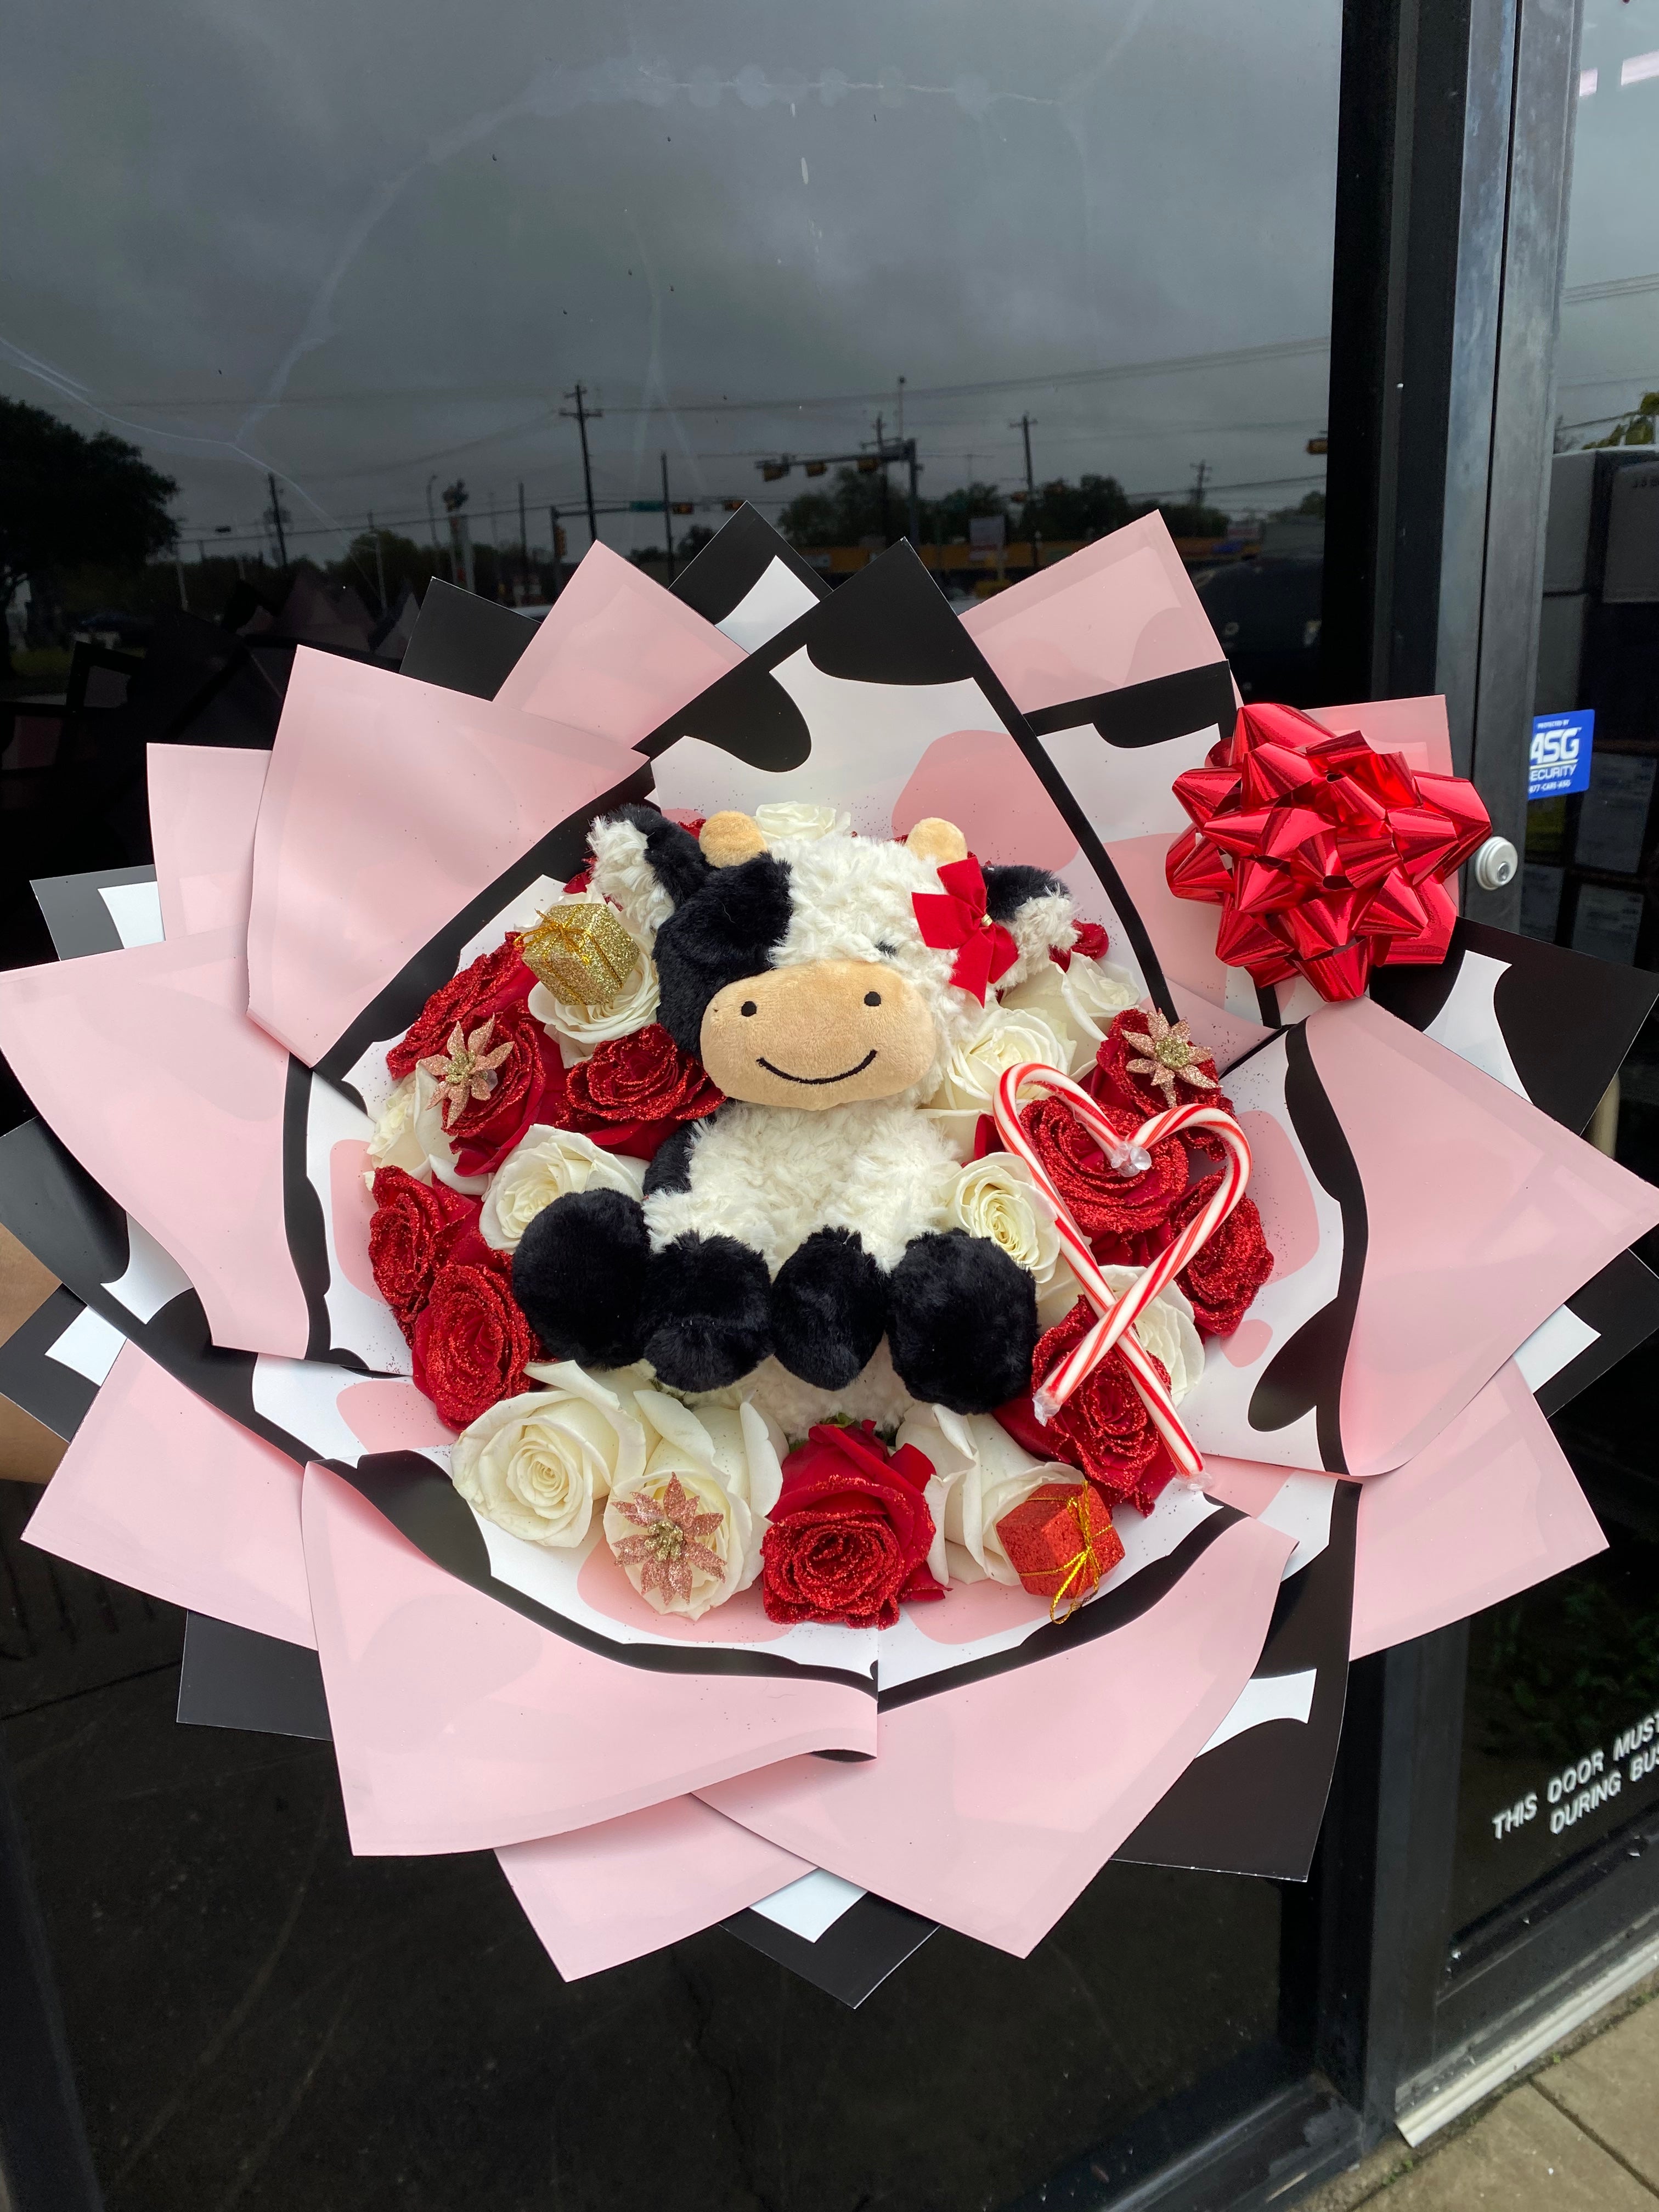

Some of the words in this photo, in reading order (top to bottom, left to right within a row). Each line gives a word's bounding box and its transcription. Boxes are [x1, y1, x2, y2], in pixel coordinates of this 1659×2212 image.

[1537, 720, 1562, 729] PROTECTED
[1530, 727, 1580, 764] ASG
[1530, 764, 1577, 781] ECURITY
[1491, 1792, 1538, 1839] THIS
[1547, 1749, 1604, 1803] DOOR
[1549, 1770, 1622, 1834] DURING
